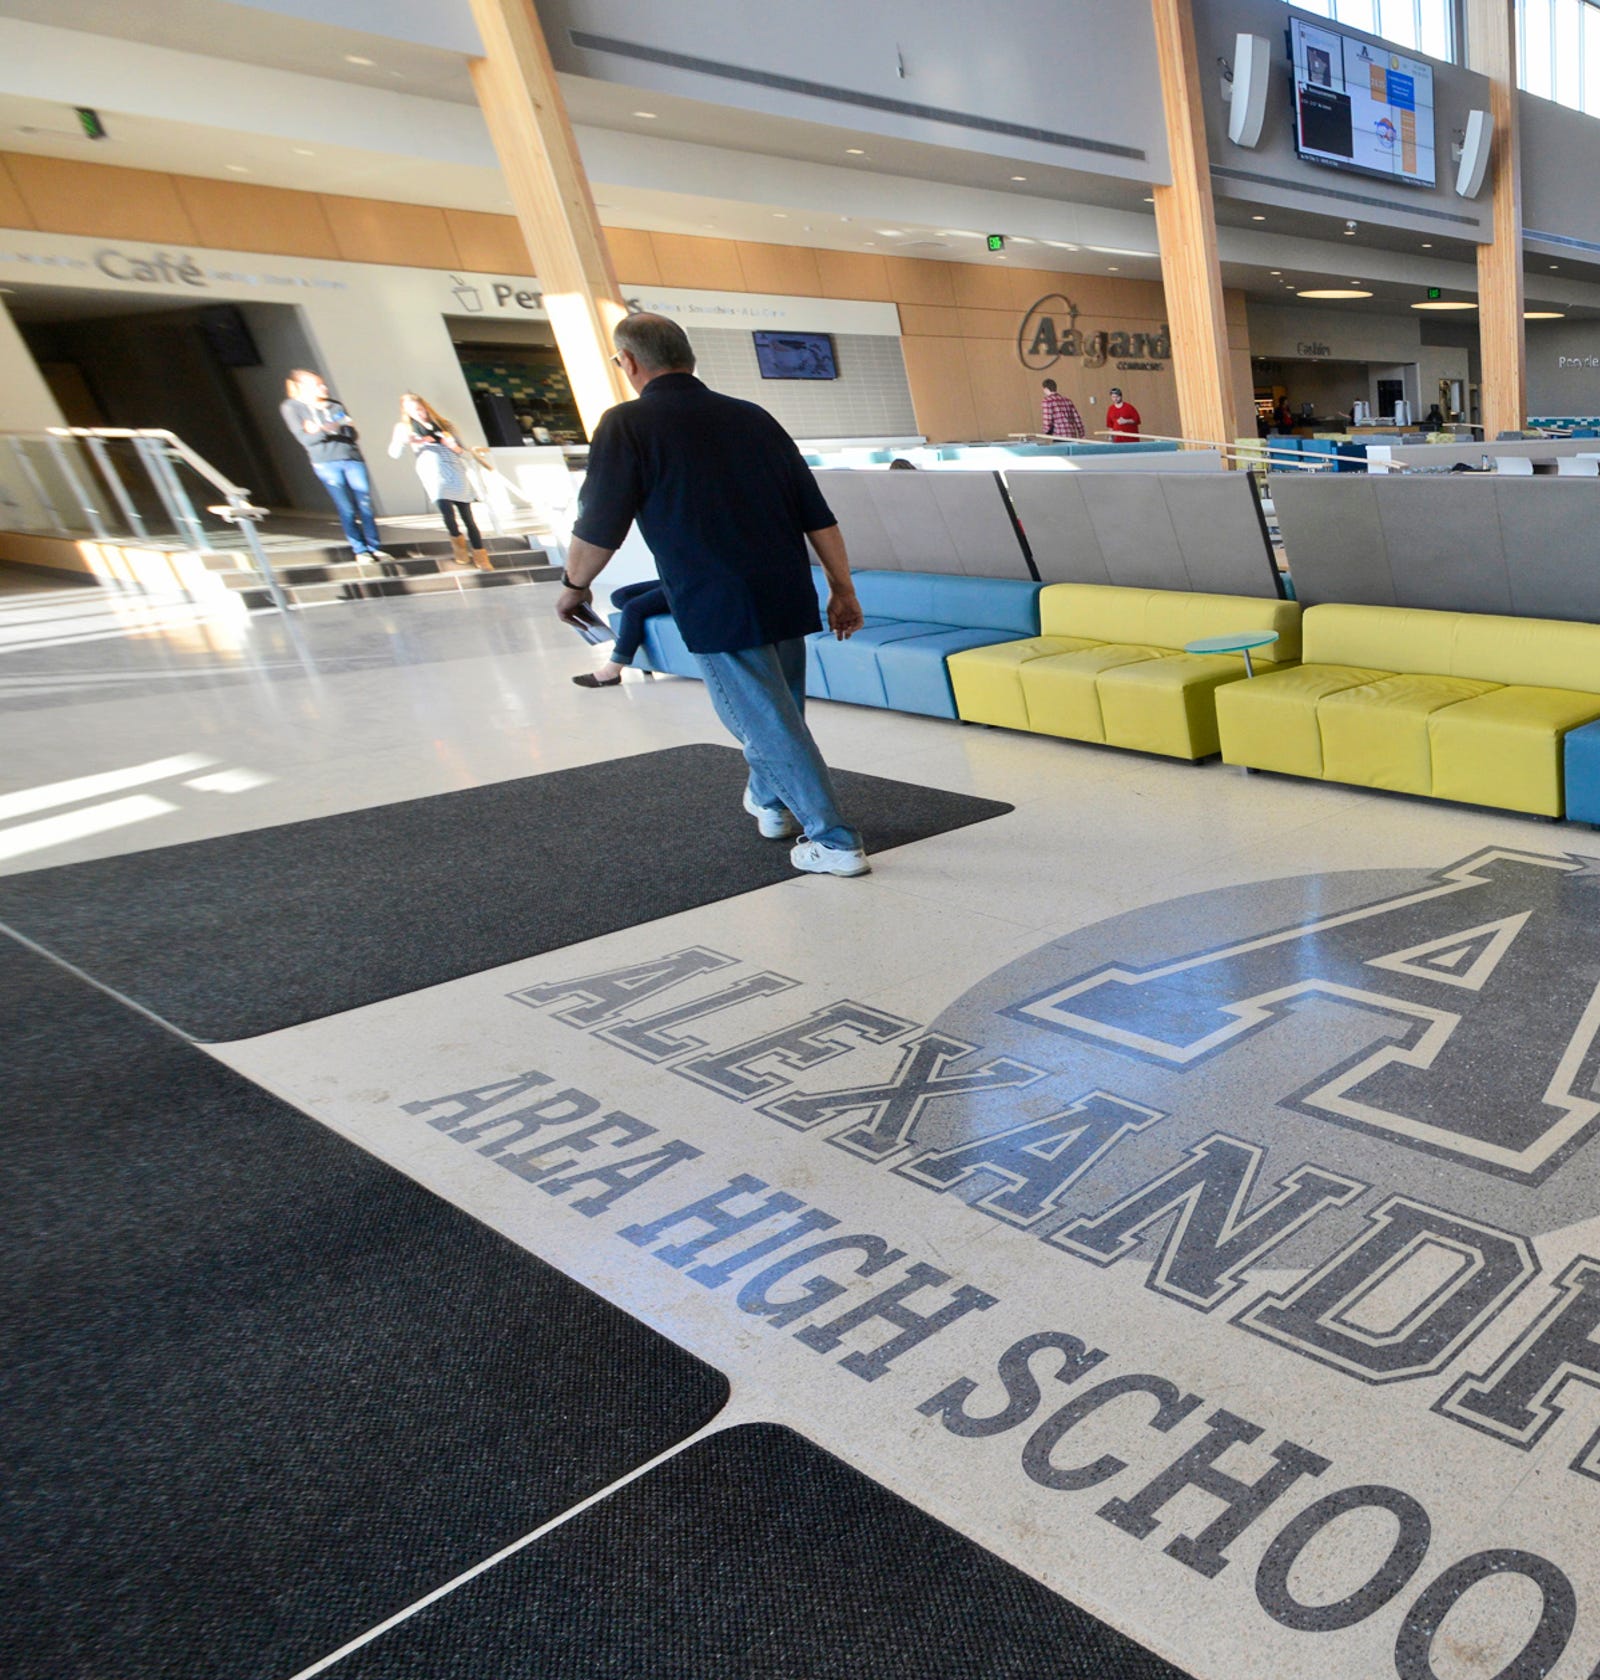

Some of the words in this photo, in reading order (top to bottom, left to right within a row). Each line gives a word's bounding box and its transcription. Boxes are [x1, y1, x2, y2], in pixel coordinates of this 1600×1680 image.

[92, 248, 208, 287] Café
[1028, 317, 1171, 369] Aagard
[398, 1070, 704, 1218] AREA
[616, 1173, 999, 1382] HIGH
